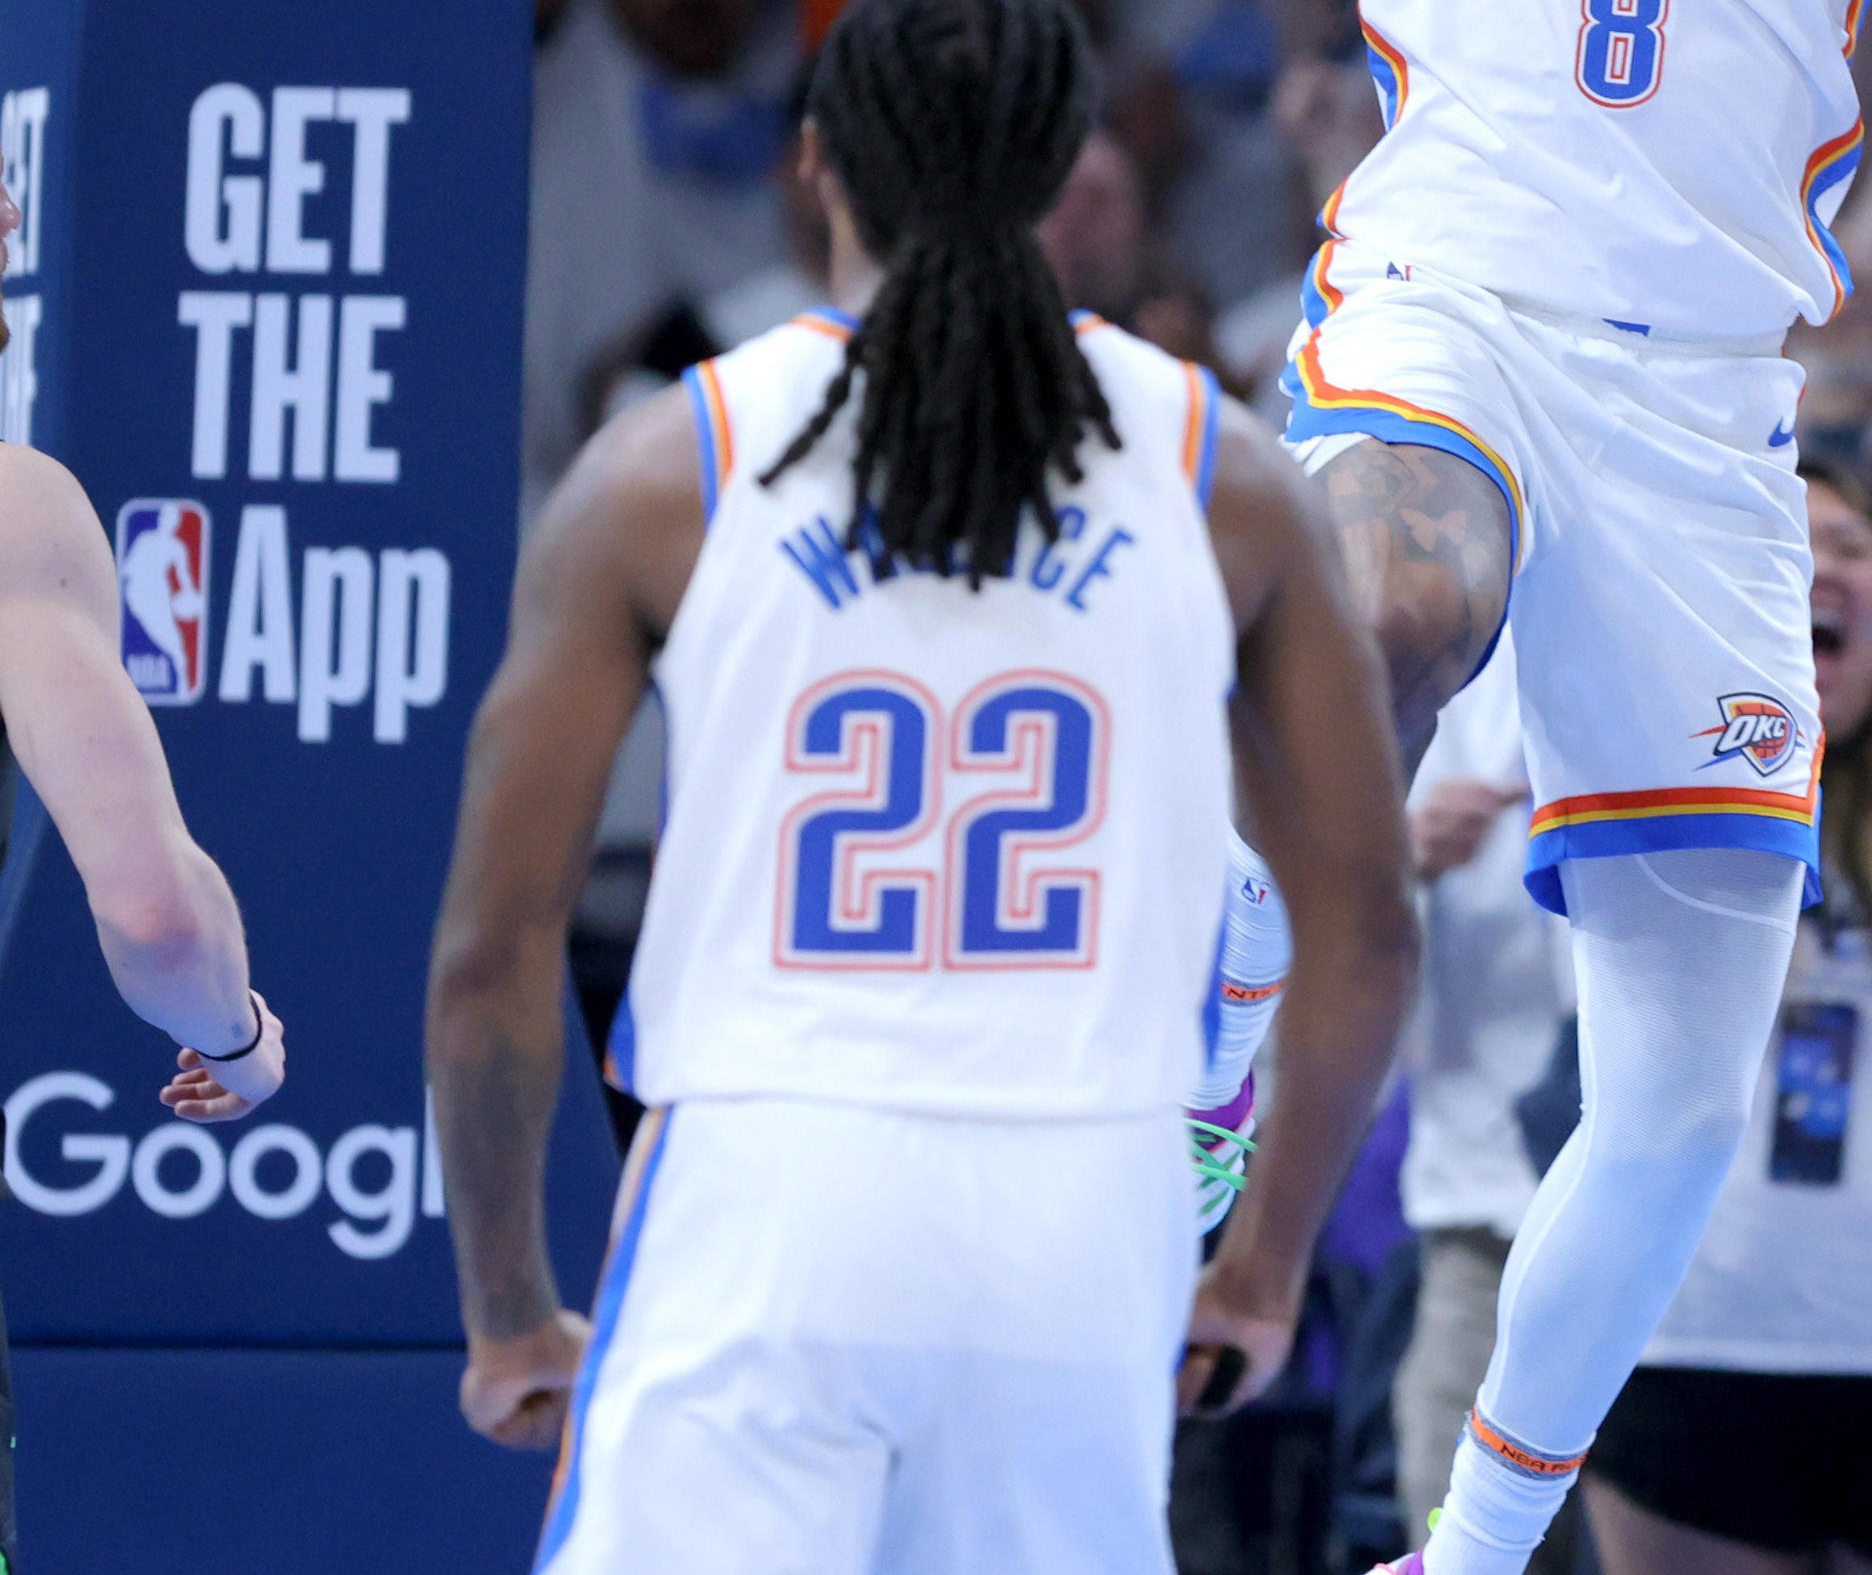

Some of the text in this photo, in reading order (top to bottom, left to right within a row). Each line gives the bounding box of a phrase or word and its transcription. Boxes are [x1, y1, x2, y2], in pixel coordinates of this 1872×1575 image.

[184, 82, 411, 275] GET
[177, 291, 407, 483] THE
[218, 504, 451, 744] App
[772, 667, 1114, 973] 22
[1714, 714, 1788, 756] OKC
[2, 1070, 448, 1261] Googl
